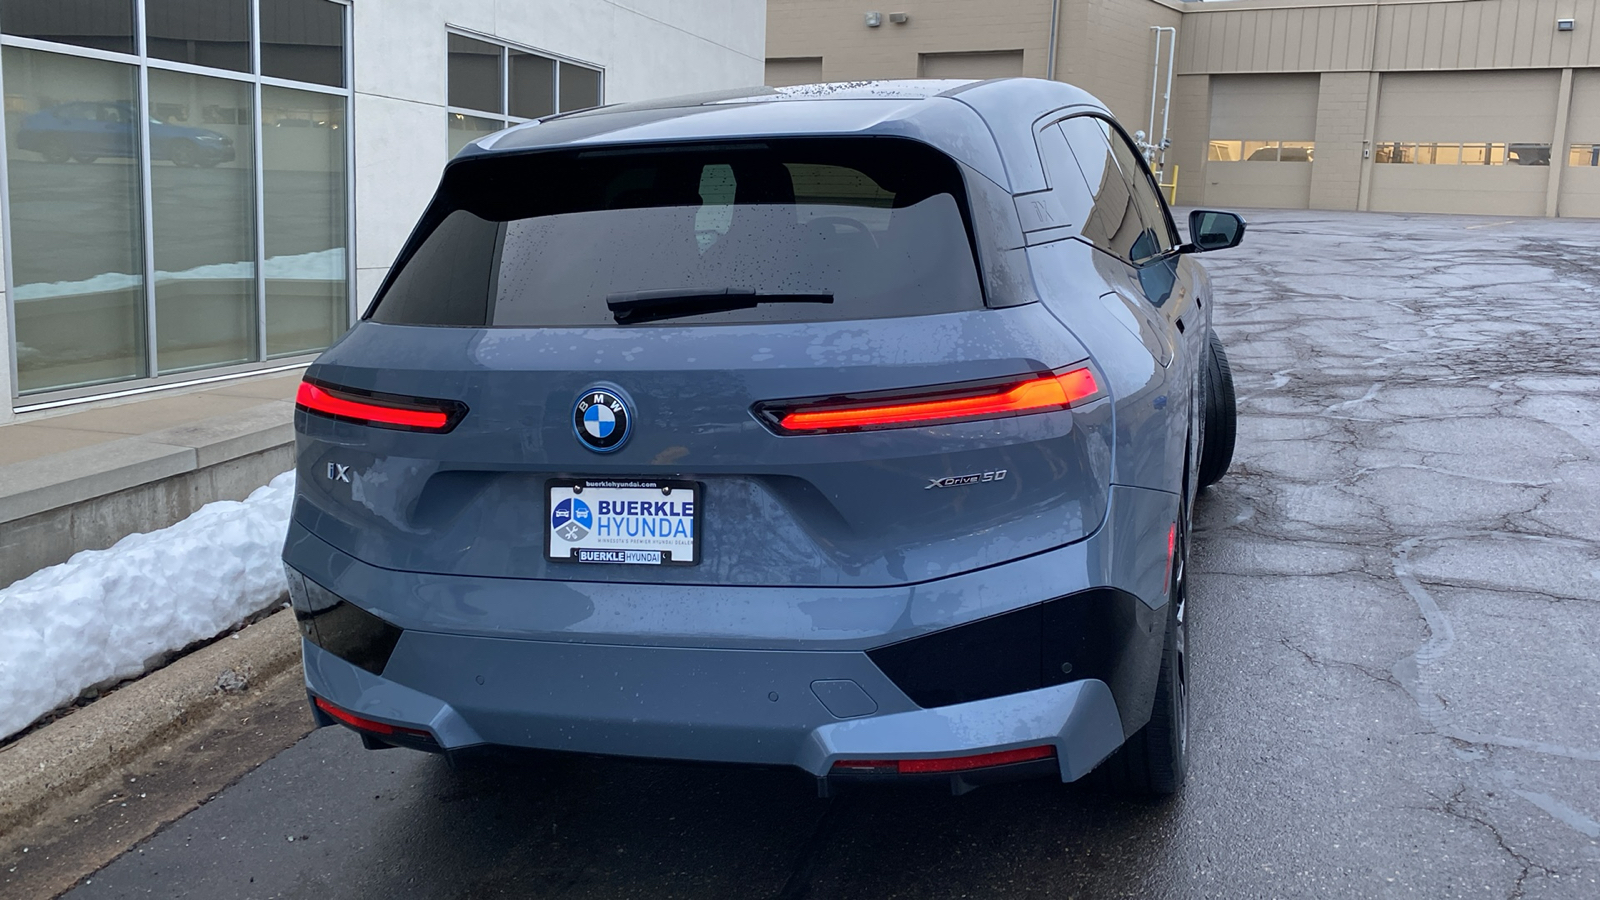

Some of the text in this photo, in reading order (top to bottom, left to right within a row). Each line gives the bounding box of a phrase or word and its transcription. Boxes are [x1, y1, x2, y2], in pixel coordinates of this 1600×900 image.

[579, 394, 622, 413] BMW
[327, 462, 350, 483] iX
[982, 469, 1007, 482] 50
[586, 481, 657, 489] buerklehyundai.com
[598, 500, 694, 517] BUERKLE
[597, 517, 694, 538] HYUNDAI
[580, 551, 659, 563] BUERKLE HYUNDAI
